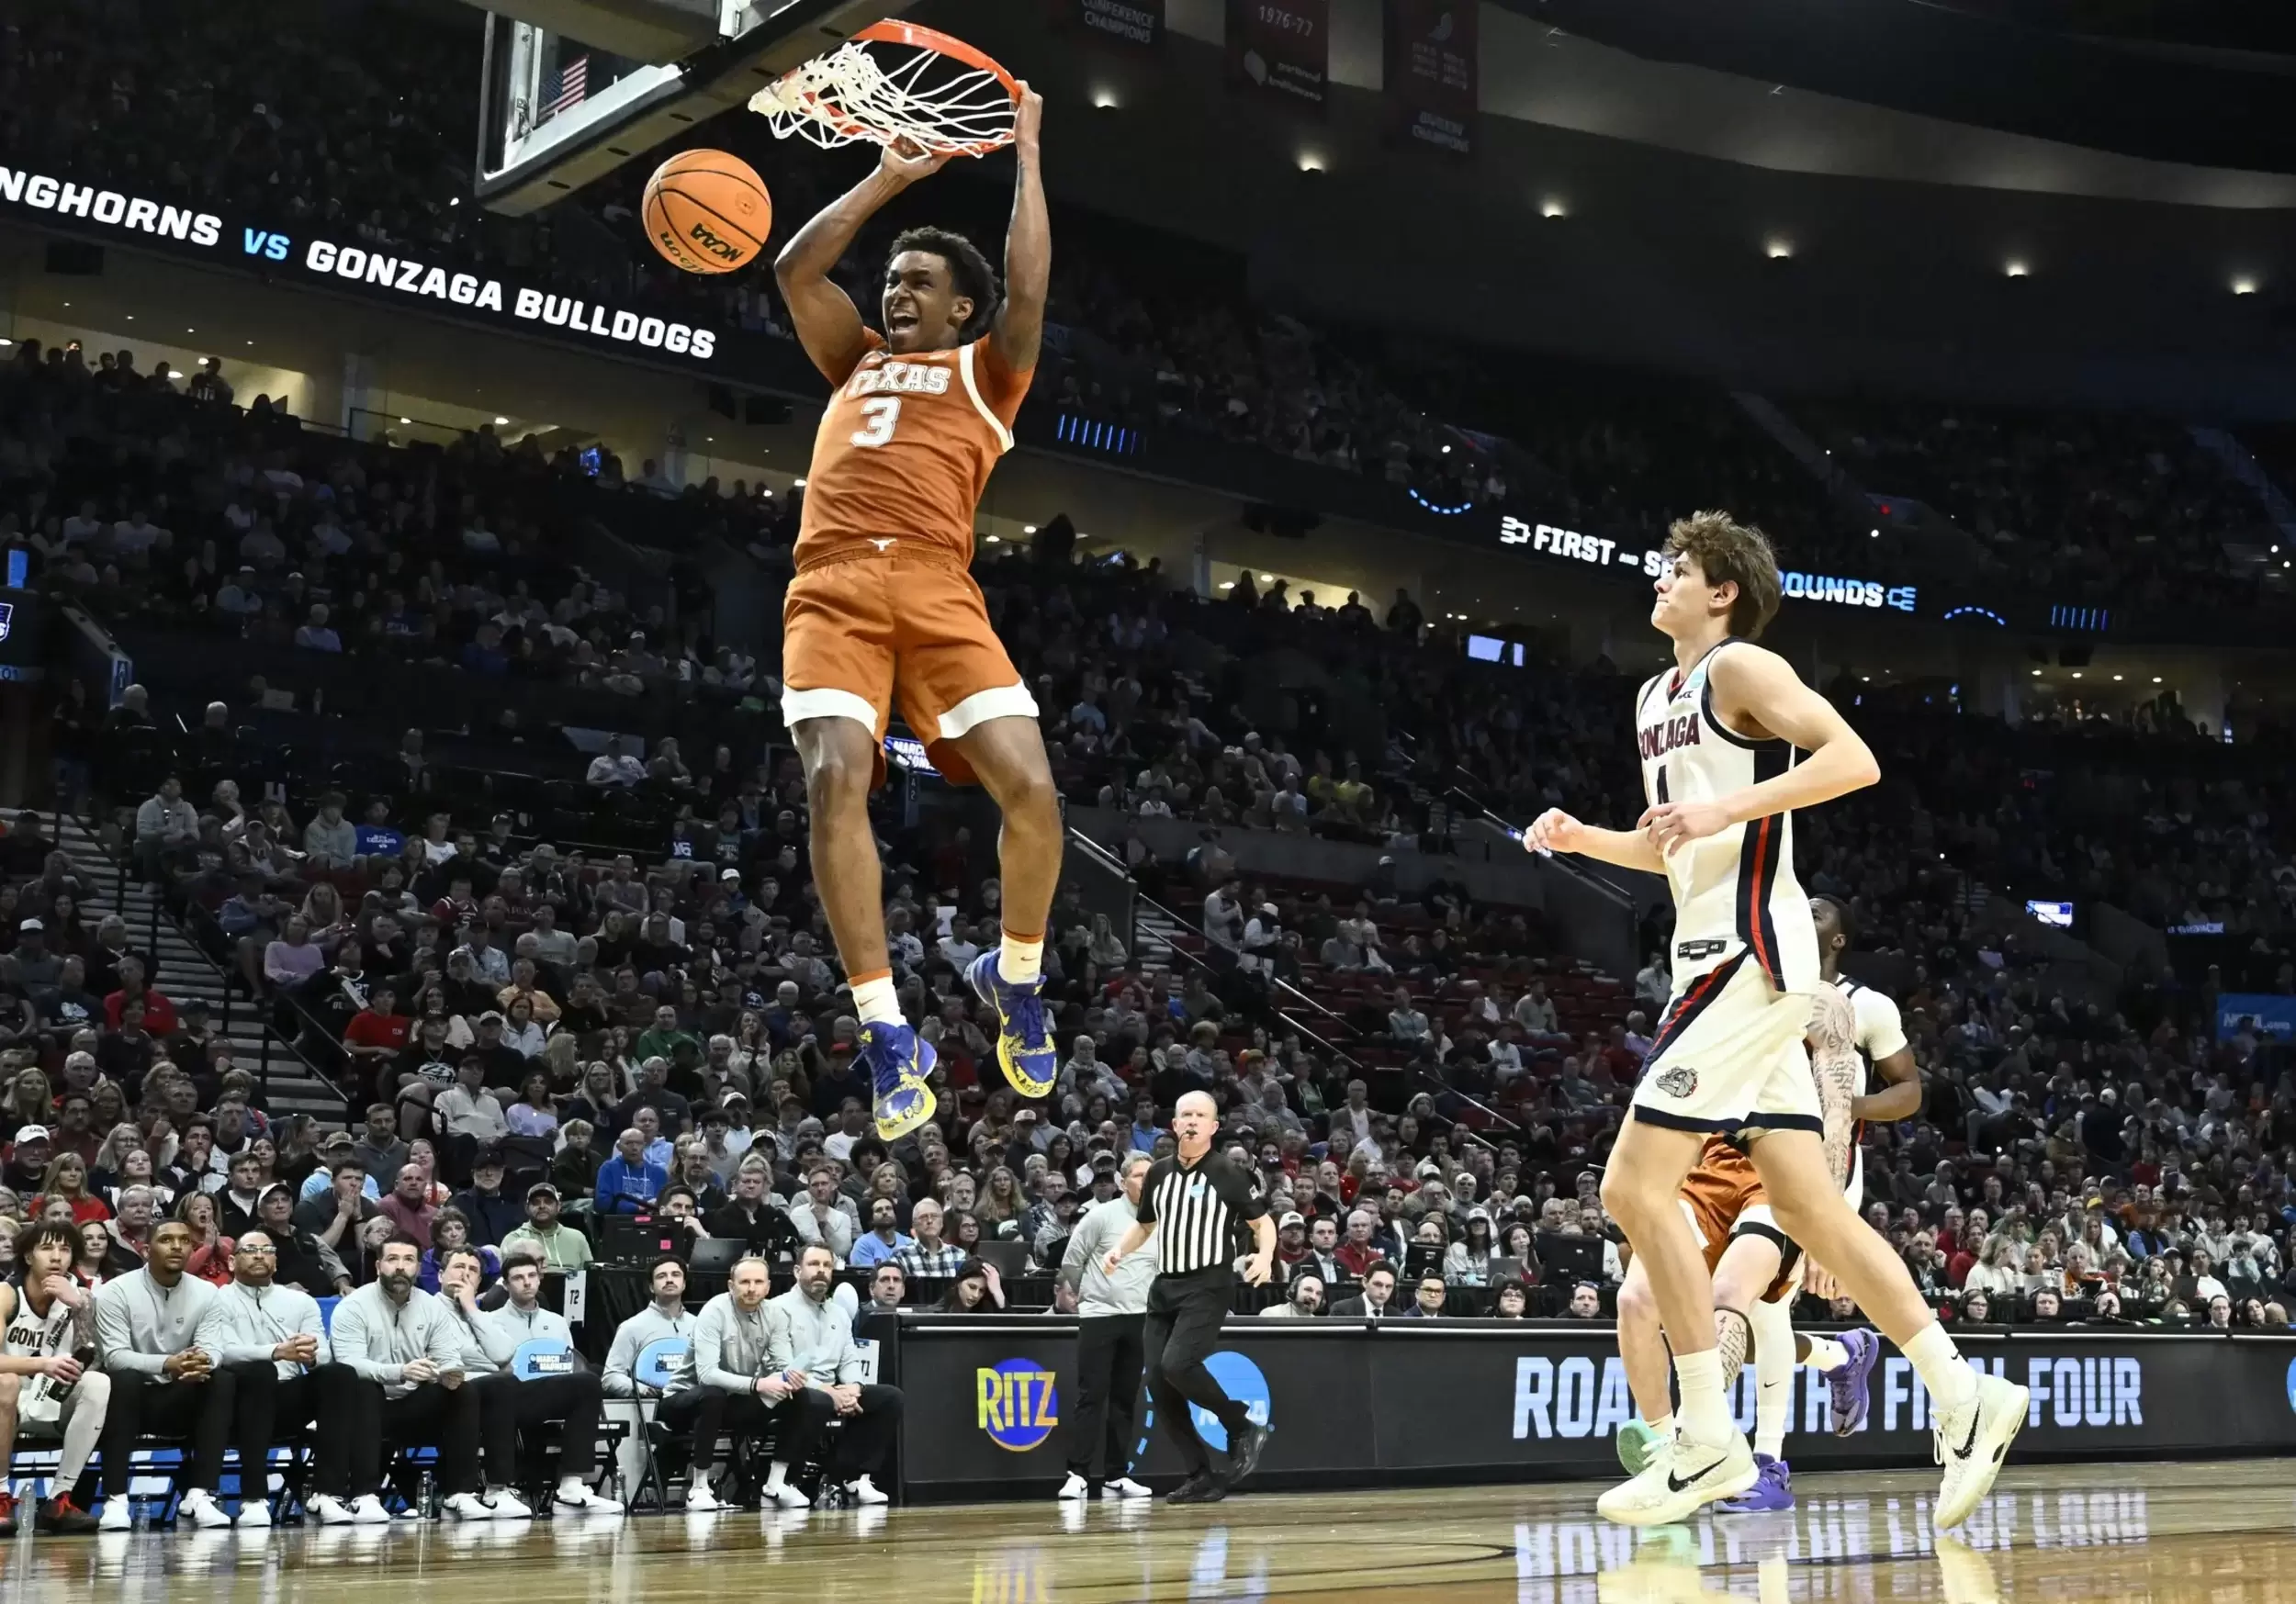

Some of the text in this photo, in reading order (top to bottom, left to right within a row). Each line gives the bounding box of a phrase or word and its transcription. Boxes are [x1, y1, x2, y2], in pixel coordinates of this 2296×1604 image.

[1259, 5, 1313, 38] 1976-77
[0, 166, 716, 359] NGHORNS VS GONZAGA BULLDOGS
[690, 222, 745, 263] NCAA
[850, 397, 902, 448] 3
[1534, 524, 1615, 566] FIRST
[893, 740, 926, 757] MARC
[570, 1289, 580, 1305] T2
[977, 1368, 1058, 1431] RITZ
[1199, 1400, 1267, 1426] NA
[1514, 1357, 1643, 1439] ROA
[2028, 1357, 2143, 1428] FOUR
